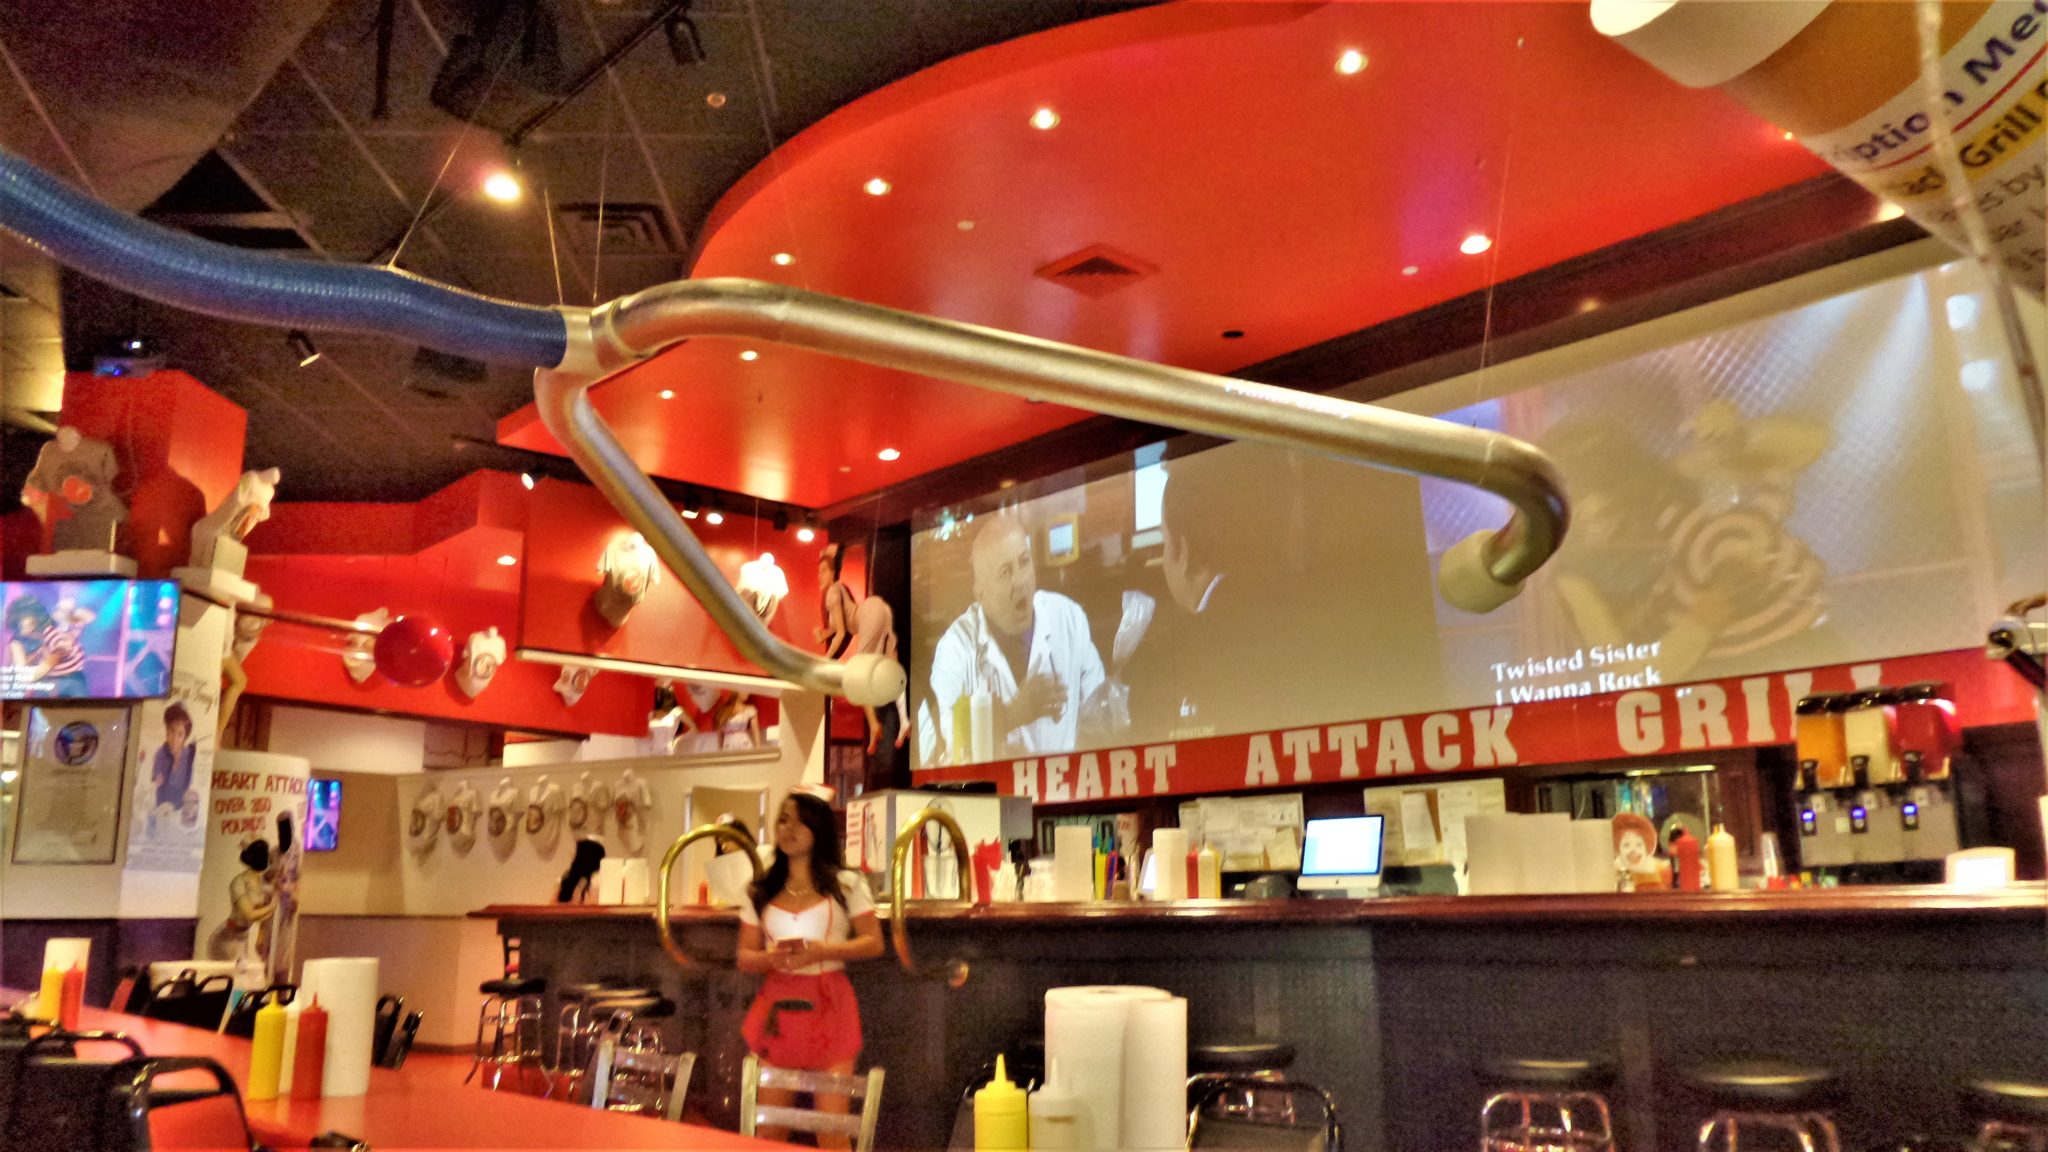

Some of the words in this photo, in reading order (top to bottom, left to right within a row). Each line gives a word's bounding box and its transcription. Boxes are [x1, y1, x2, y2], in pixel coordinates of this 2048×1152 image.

[1959, 103, 2042, 168] Grill
[1490, 648, 1584, 682] Twisted
[1589, 640, 1662, 667] Sister
[1510, 680, 1592, 704] Wanna
[1599, 665, 1662, 693] Rock
[1012, 744, 1176, 803] HEART
[1244, 705, 1518, 787] ATTACK
[211, 770, 260, 790] HEART
